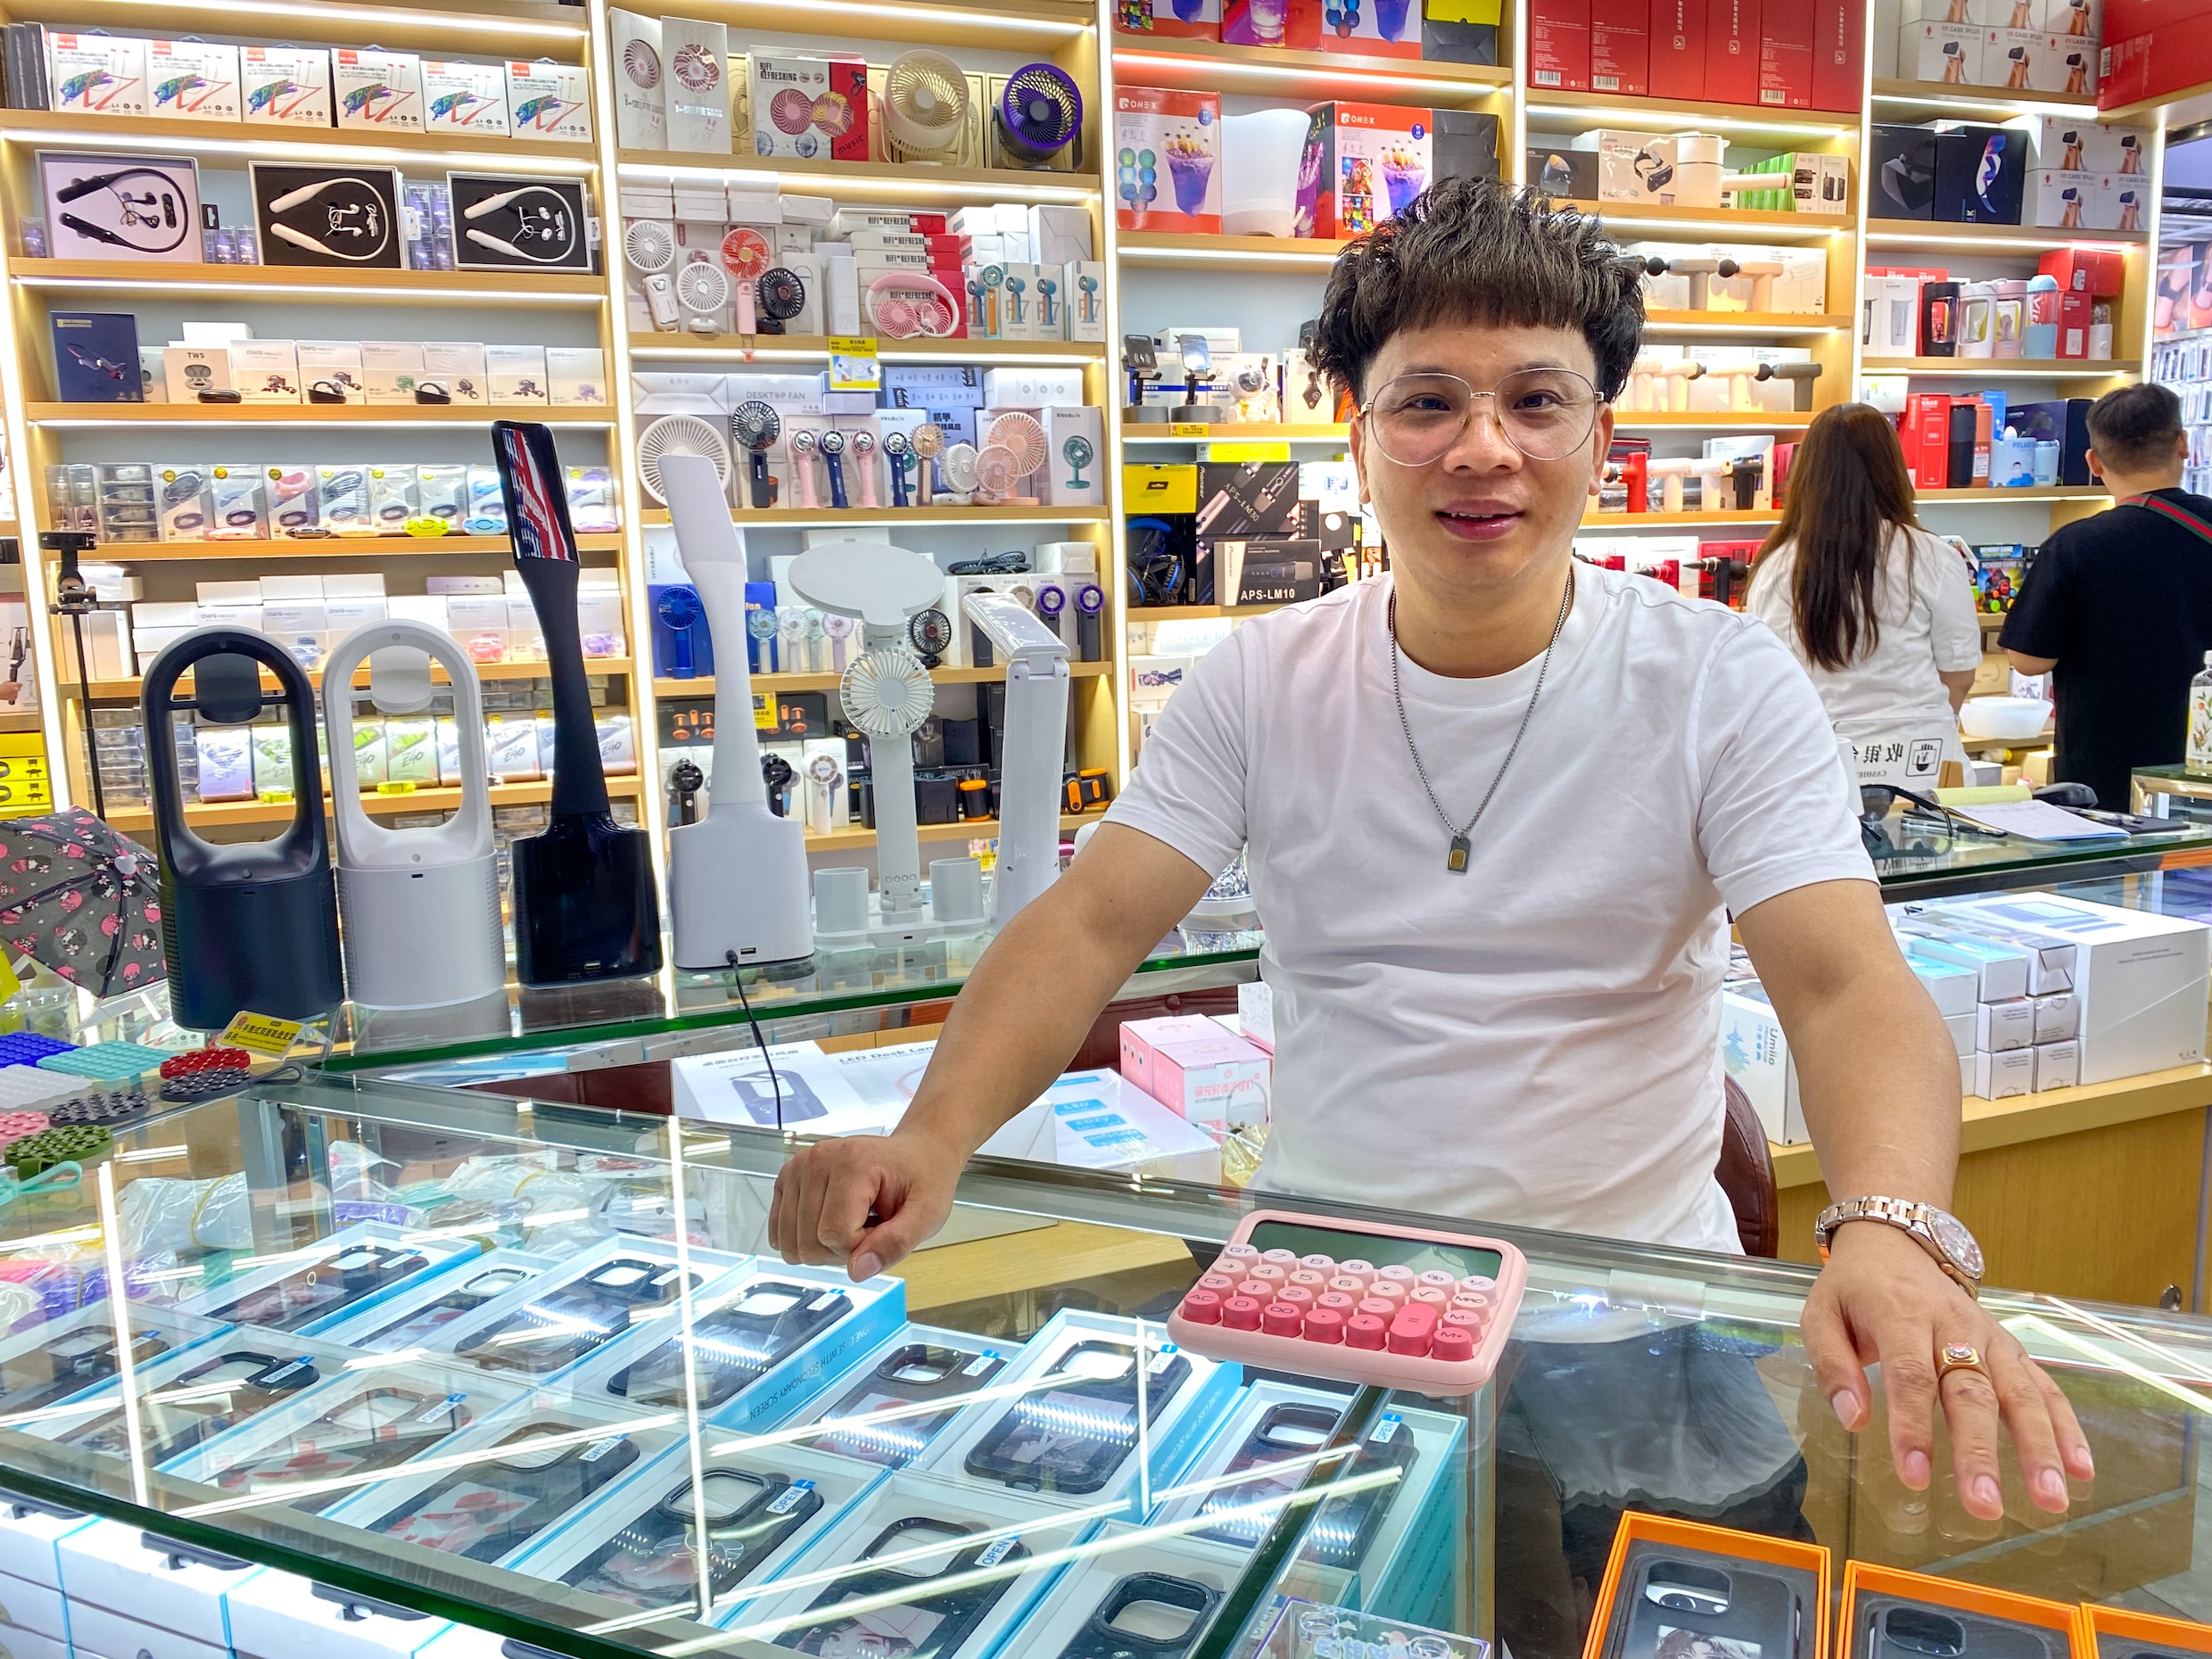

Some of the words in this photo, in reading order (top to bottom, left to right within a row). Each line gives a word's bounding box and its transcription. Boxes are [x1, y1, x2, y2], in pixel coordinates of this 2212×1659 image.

[788, 392, 805, 400] FAN
[1240, 588, 1295, 600] APS-LM10
[839, 1055, 866, 1063] LED
[871, 1050, 904, 1059] Desk
[1338, 1279, 1352, 1287] 6
[1192, 1294, 1215, 1302] AC
[1286, 1290, 1302, 1298] 2
[779, 1360, 820, 1399] SECONDARY
[749, 1391, 778, 1421] SCREEN
[1376, 1422, 1398, 1441] OPEN
[585, 1437, 615, 1460] OPEN
[772, 1489, 802, 1511] OPEN
[982, 1541, 1010, 1565] OPEN
